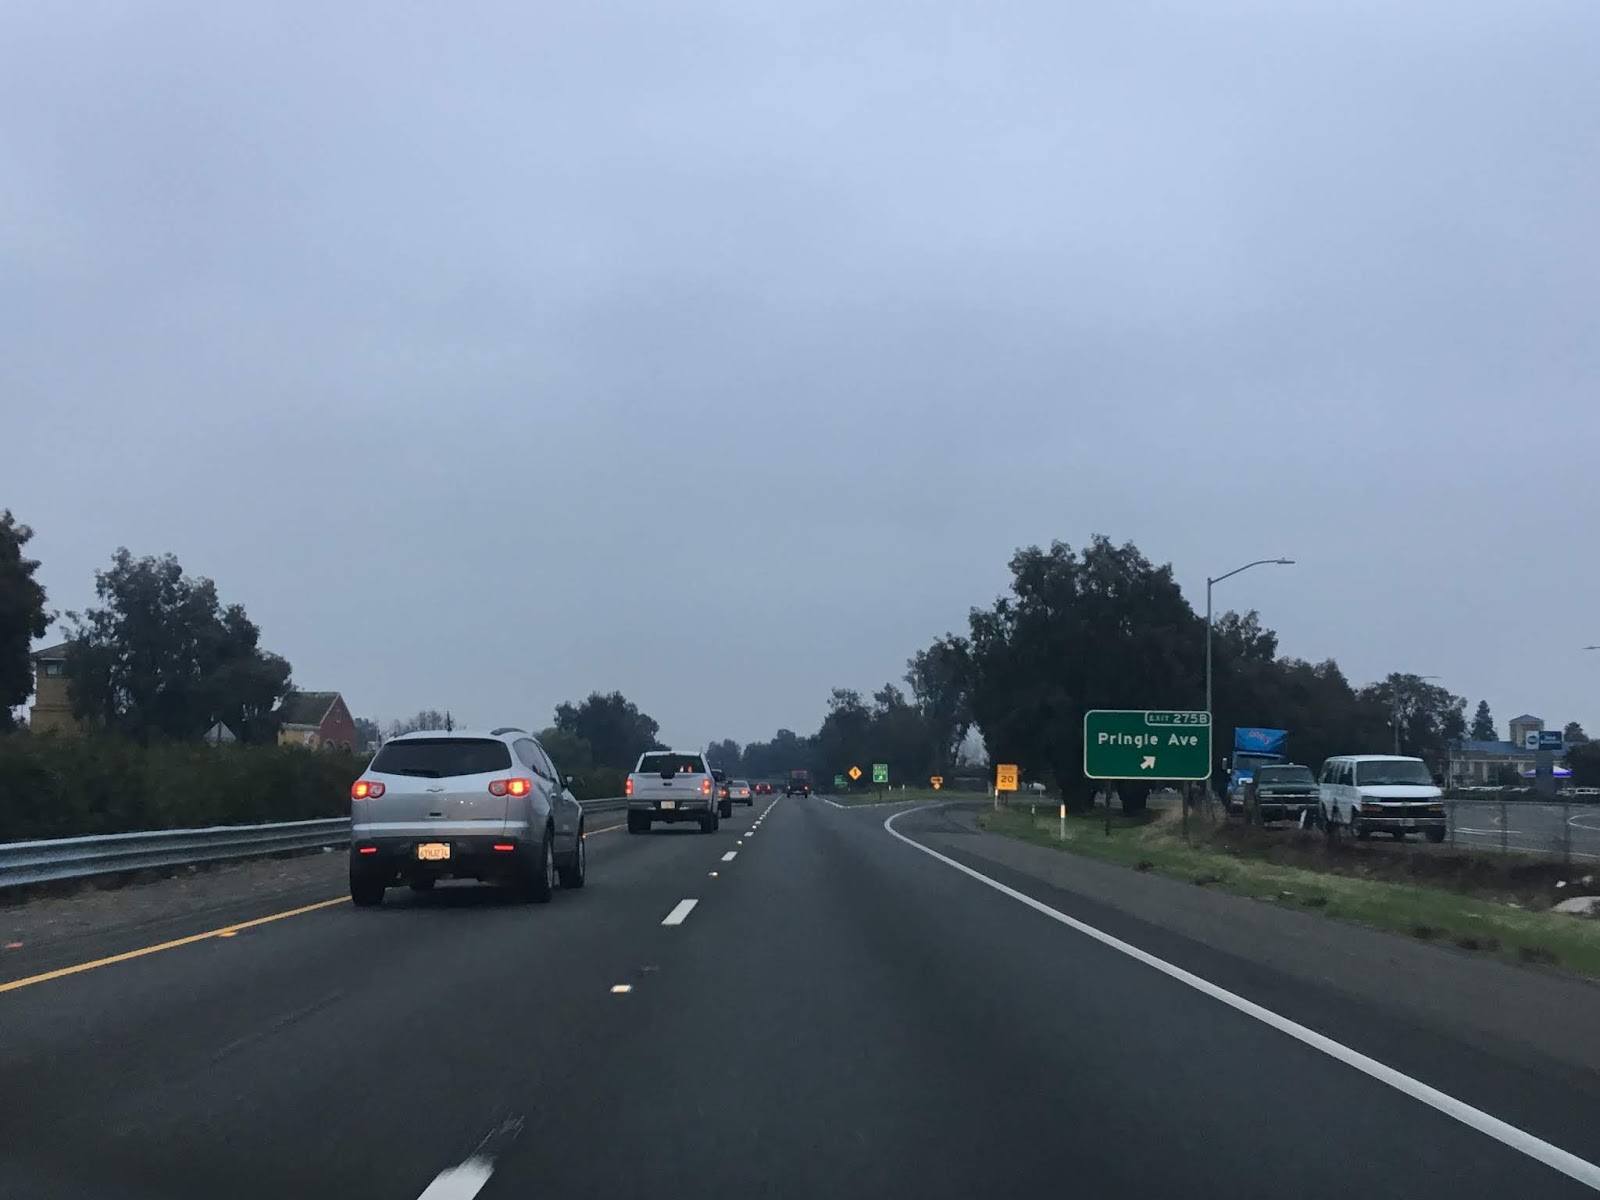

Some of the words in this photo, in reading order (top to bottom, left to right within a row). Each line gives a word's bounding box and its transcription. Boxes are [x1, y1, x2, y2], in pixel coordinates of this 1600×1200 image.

[1173, 713, 1208, 723] 275B
[1098, 732, 1159, 748] Pringle
[1168, 733, 1198, 746] Ave
[1001, 775, 1014, 783] 20
